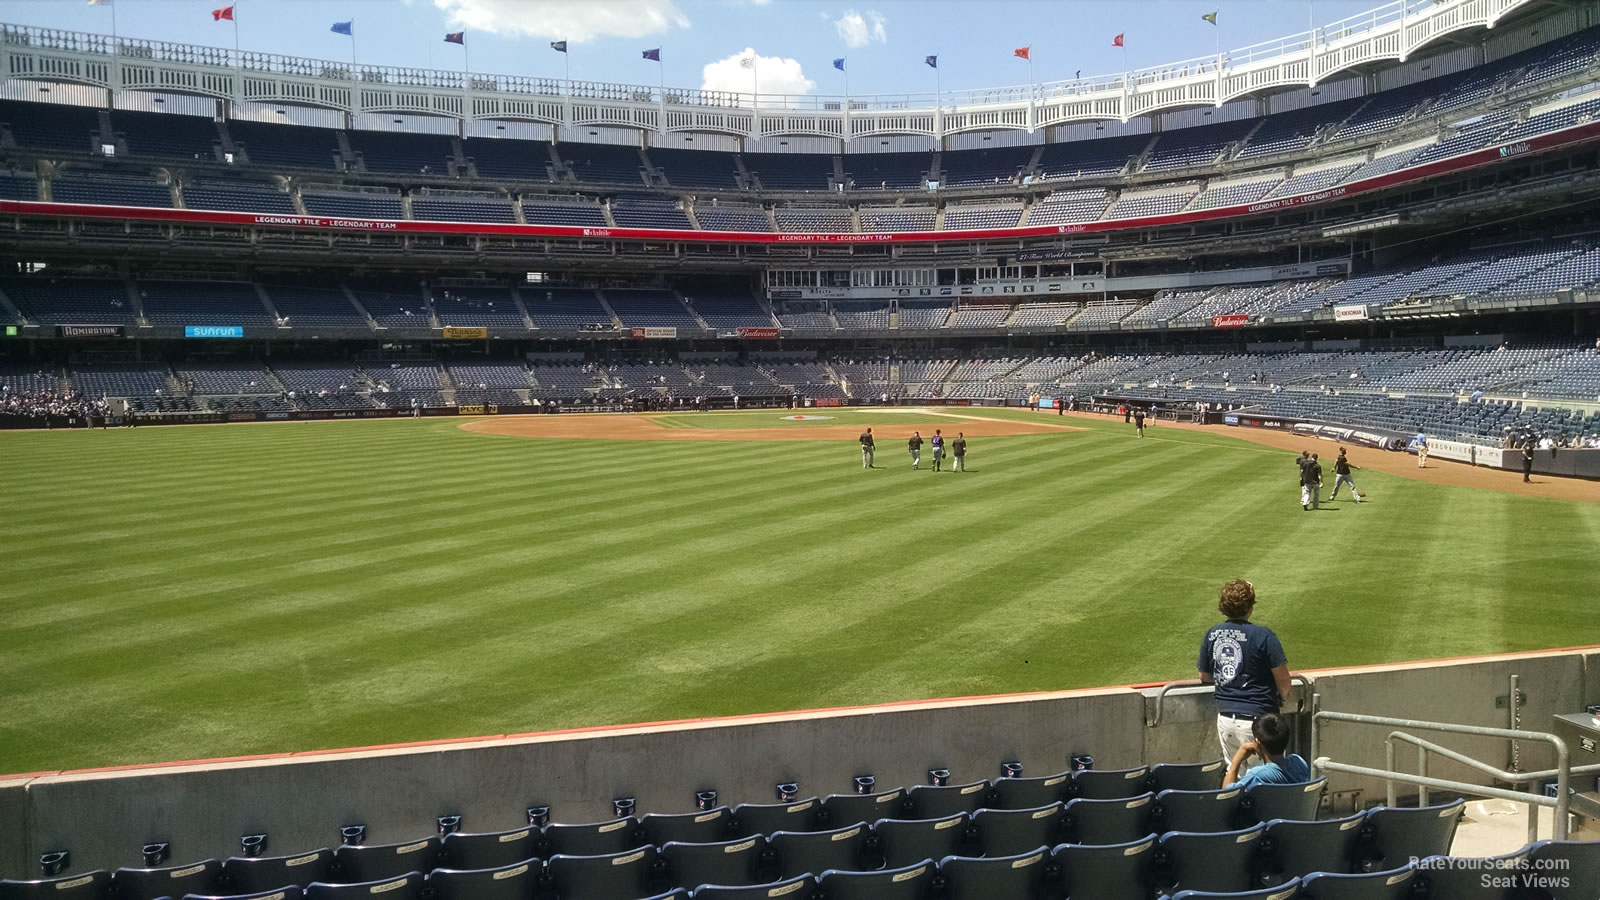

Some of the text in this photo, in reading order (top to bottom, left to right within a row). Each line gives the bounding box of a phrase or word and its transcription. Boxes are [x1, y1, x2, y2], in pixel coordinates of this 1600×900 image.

[1248, 202, 1281, 212] LEGENDARY
[1300, 193, 1332, 203] LEGENDARY
[1332, 187, 1346, 197] TEAM
[254, 216, 301, 225] LEGENDARY
[304, 218, 320, 226] TILE
[329, 220, 374, 228] LEGENDARY
[1064, 251, 1095, 259] Champions
[1213, 315, 1248, 327] Budweiser
[193, 327, 235, 336] sunrun
[738, 328, 778, 338] Budweiser
